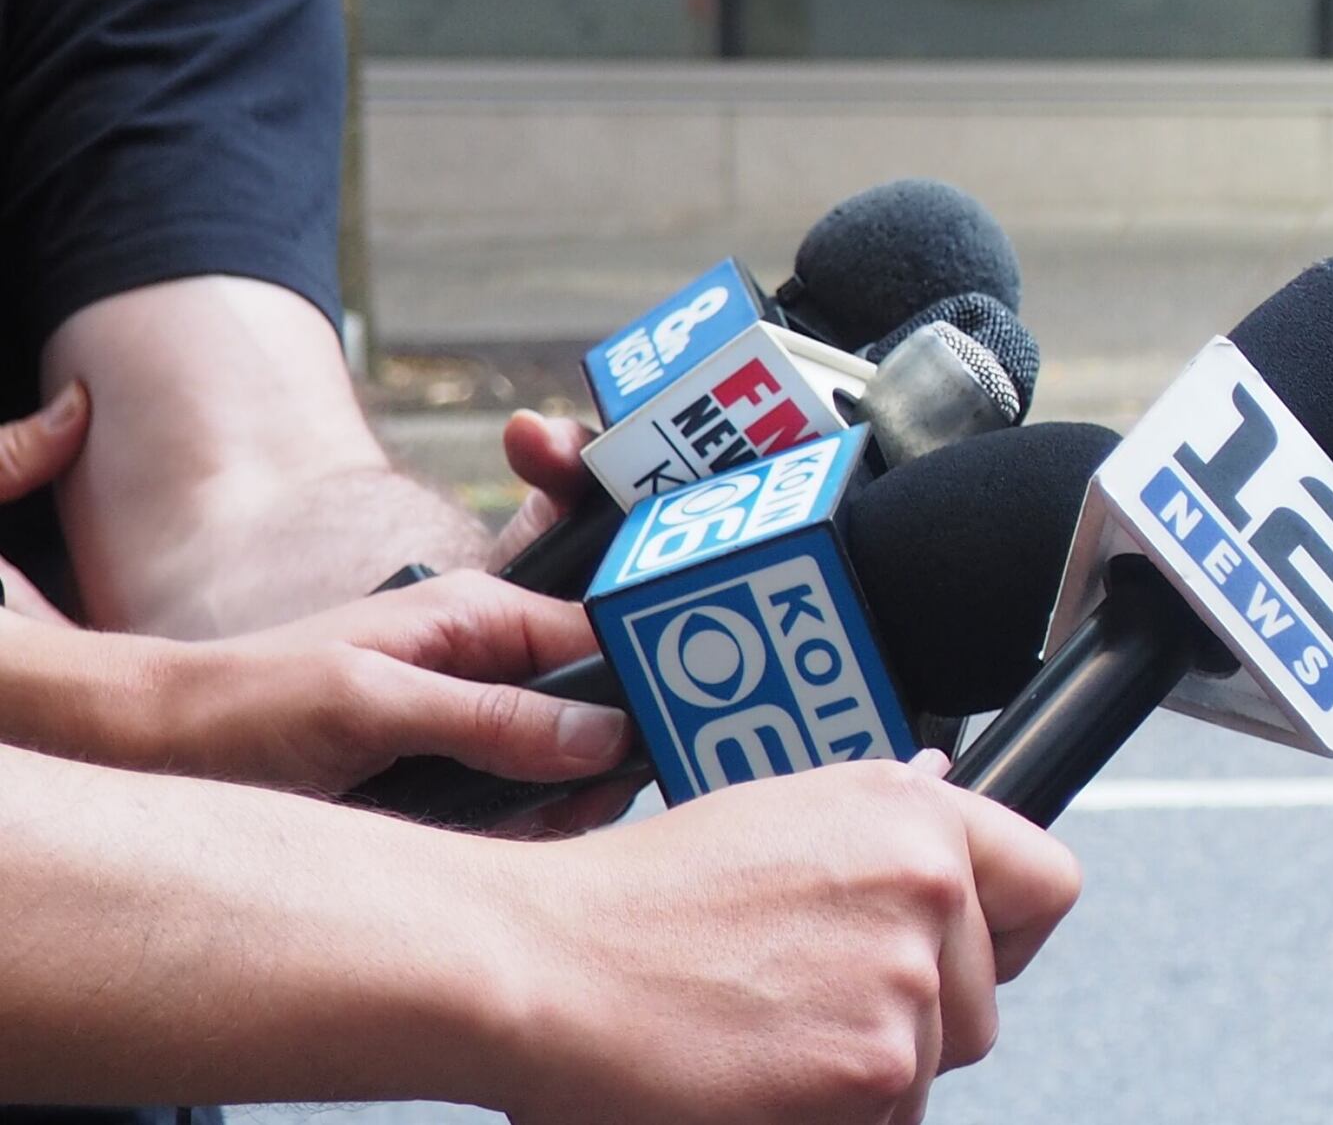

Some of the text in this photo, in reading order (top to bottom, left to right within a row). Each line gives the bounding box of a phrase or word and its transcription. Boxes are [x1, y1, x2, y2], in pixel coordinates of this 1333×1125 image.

[605, 327, 665, 396] KGW
[760, 449, 823, 525] KOIN
[1160, 490, 1328, 686] NEWS
